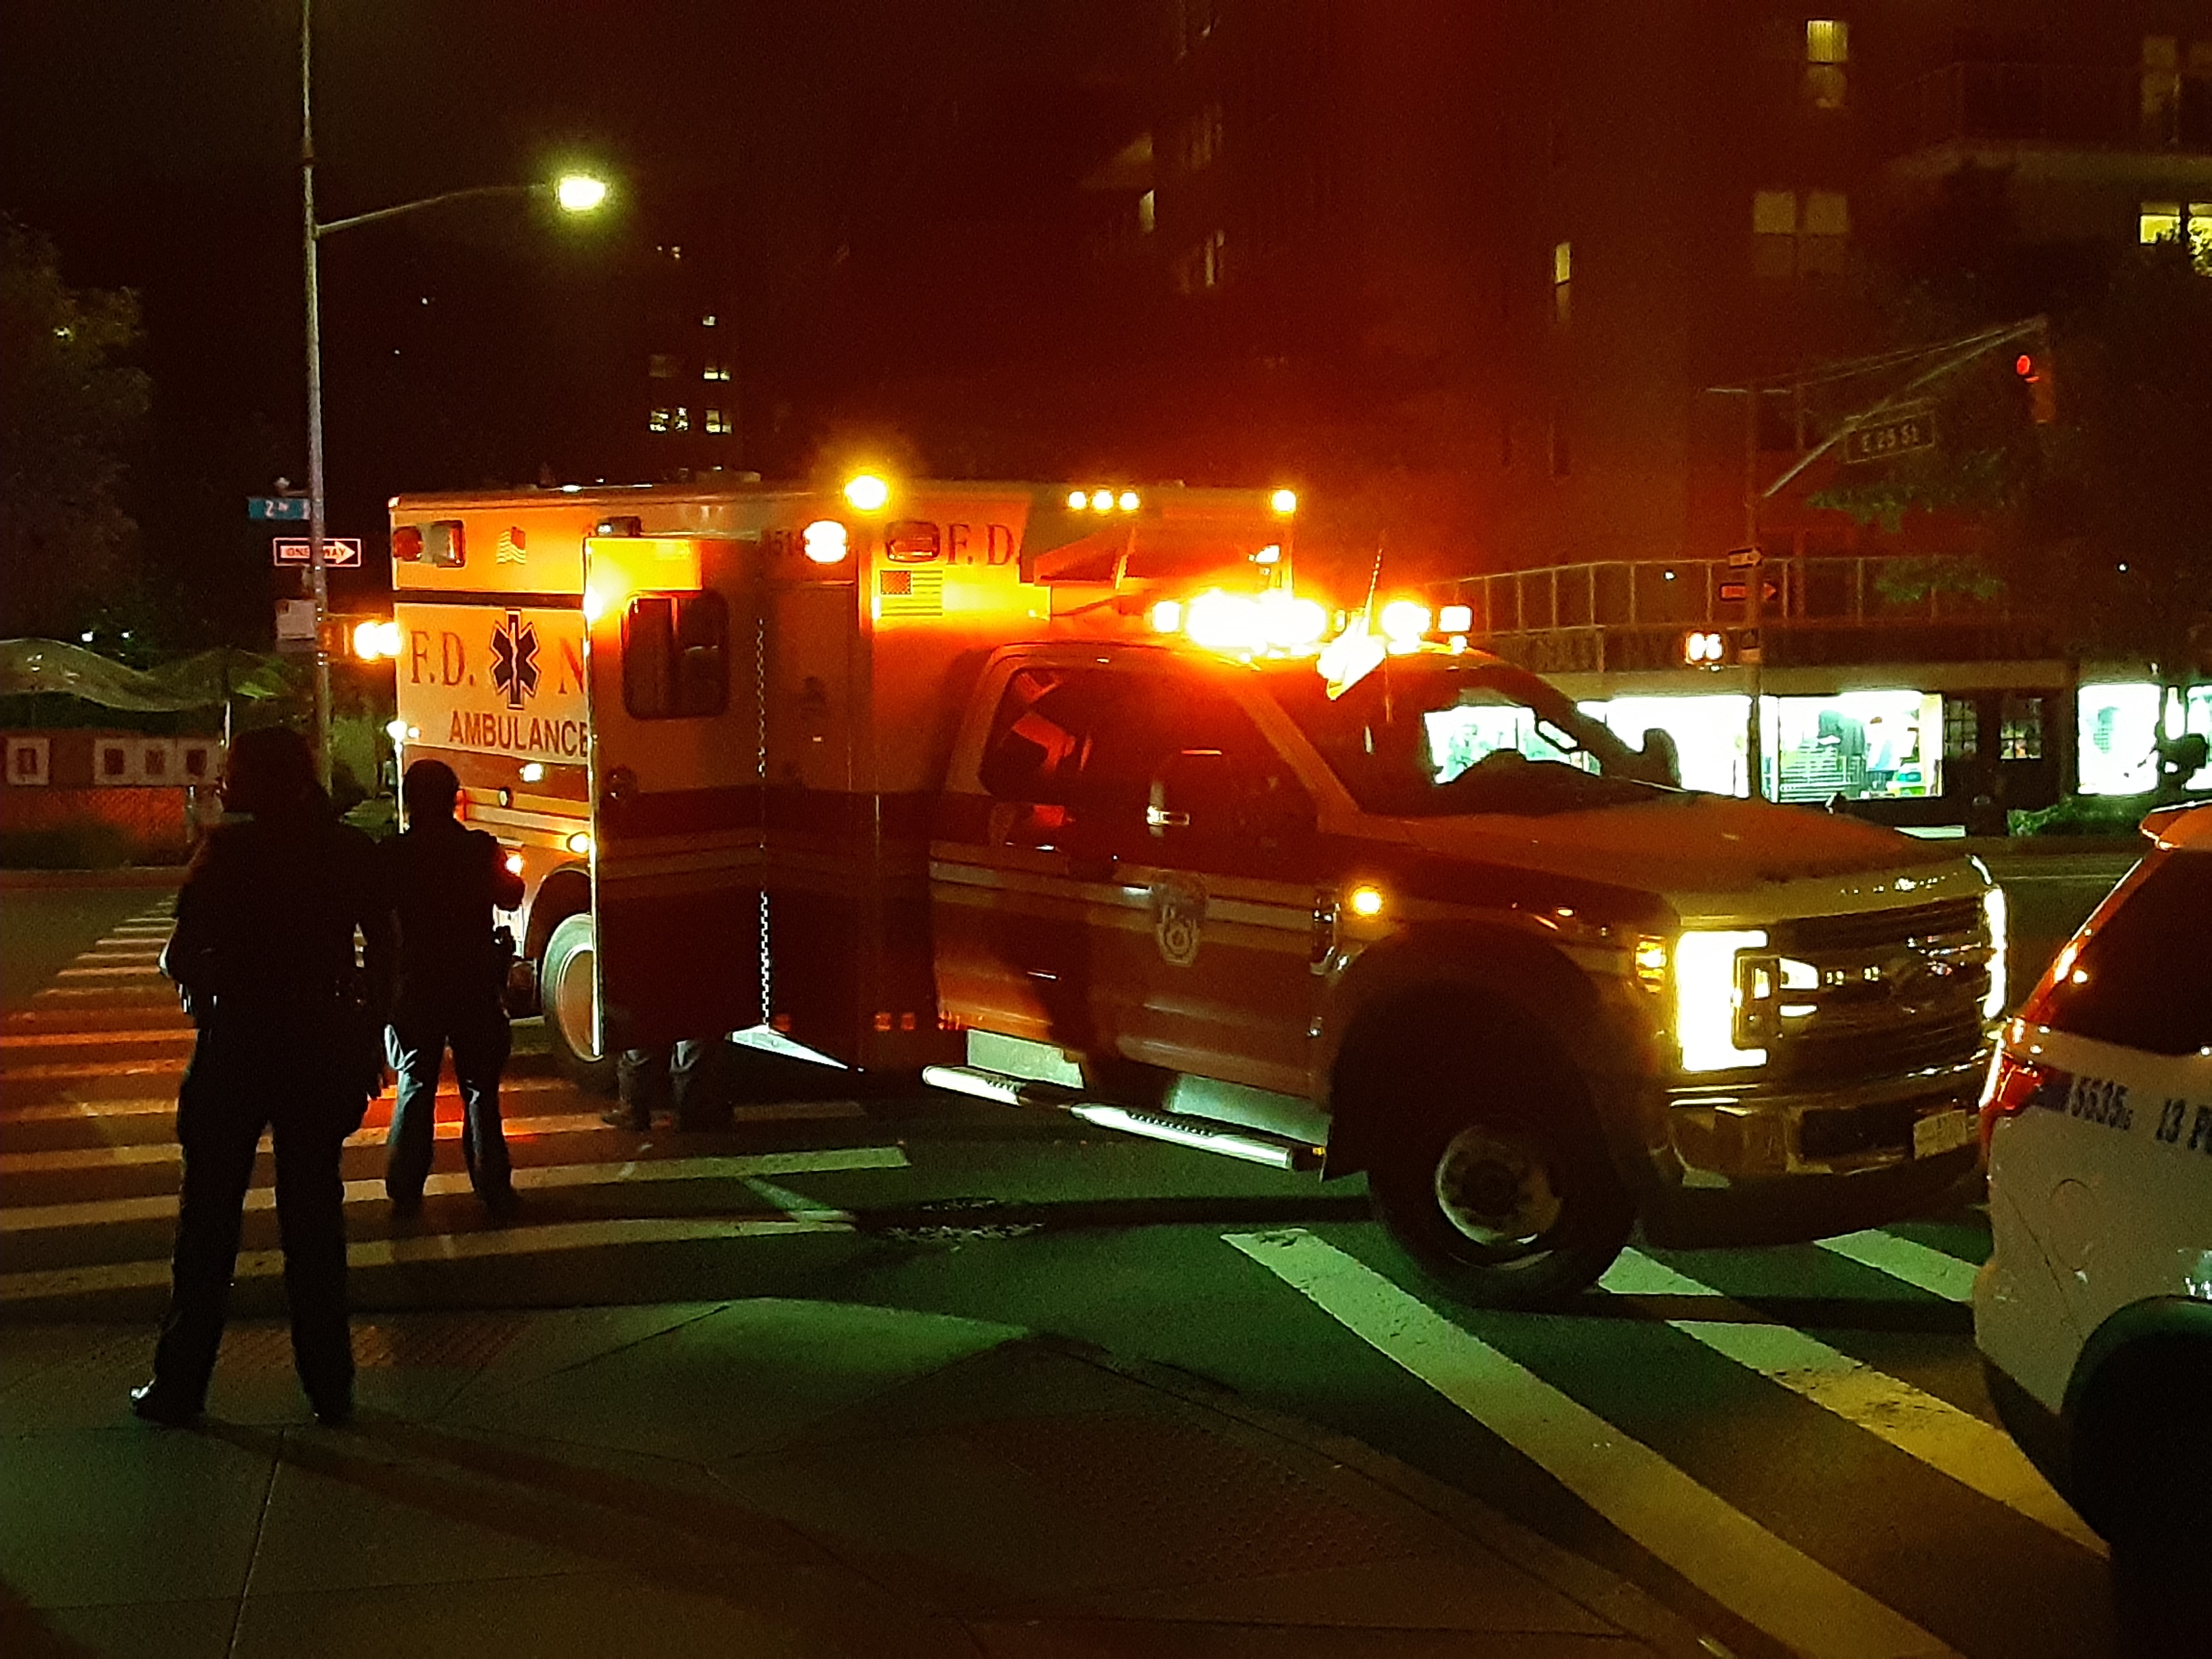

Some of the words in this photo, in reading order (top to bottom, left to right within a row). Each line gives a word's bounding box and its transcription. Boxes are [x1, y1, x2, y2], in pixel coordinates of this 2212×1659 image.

[264, 499, 274, 517] 2
[410, 630, 475, 686] F.D.
[448, 710, 588, 758] AMBULANCE
